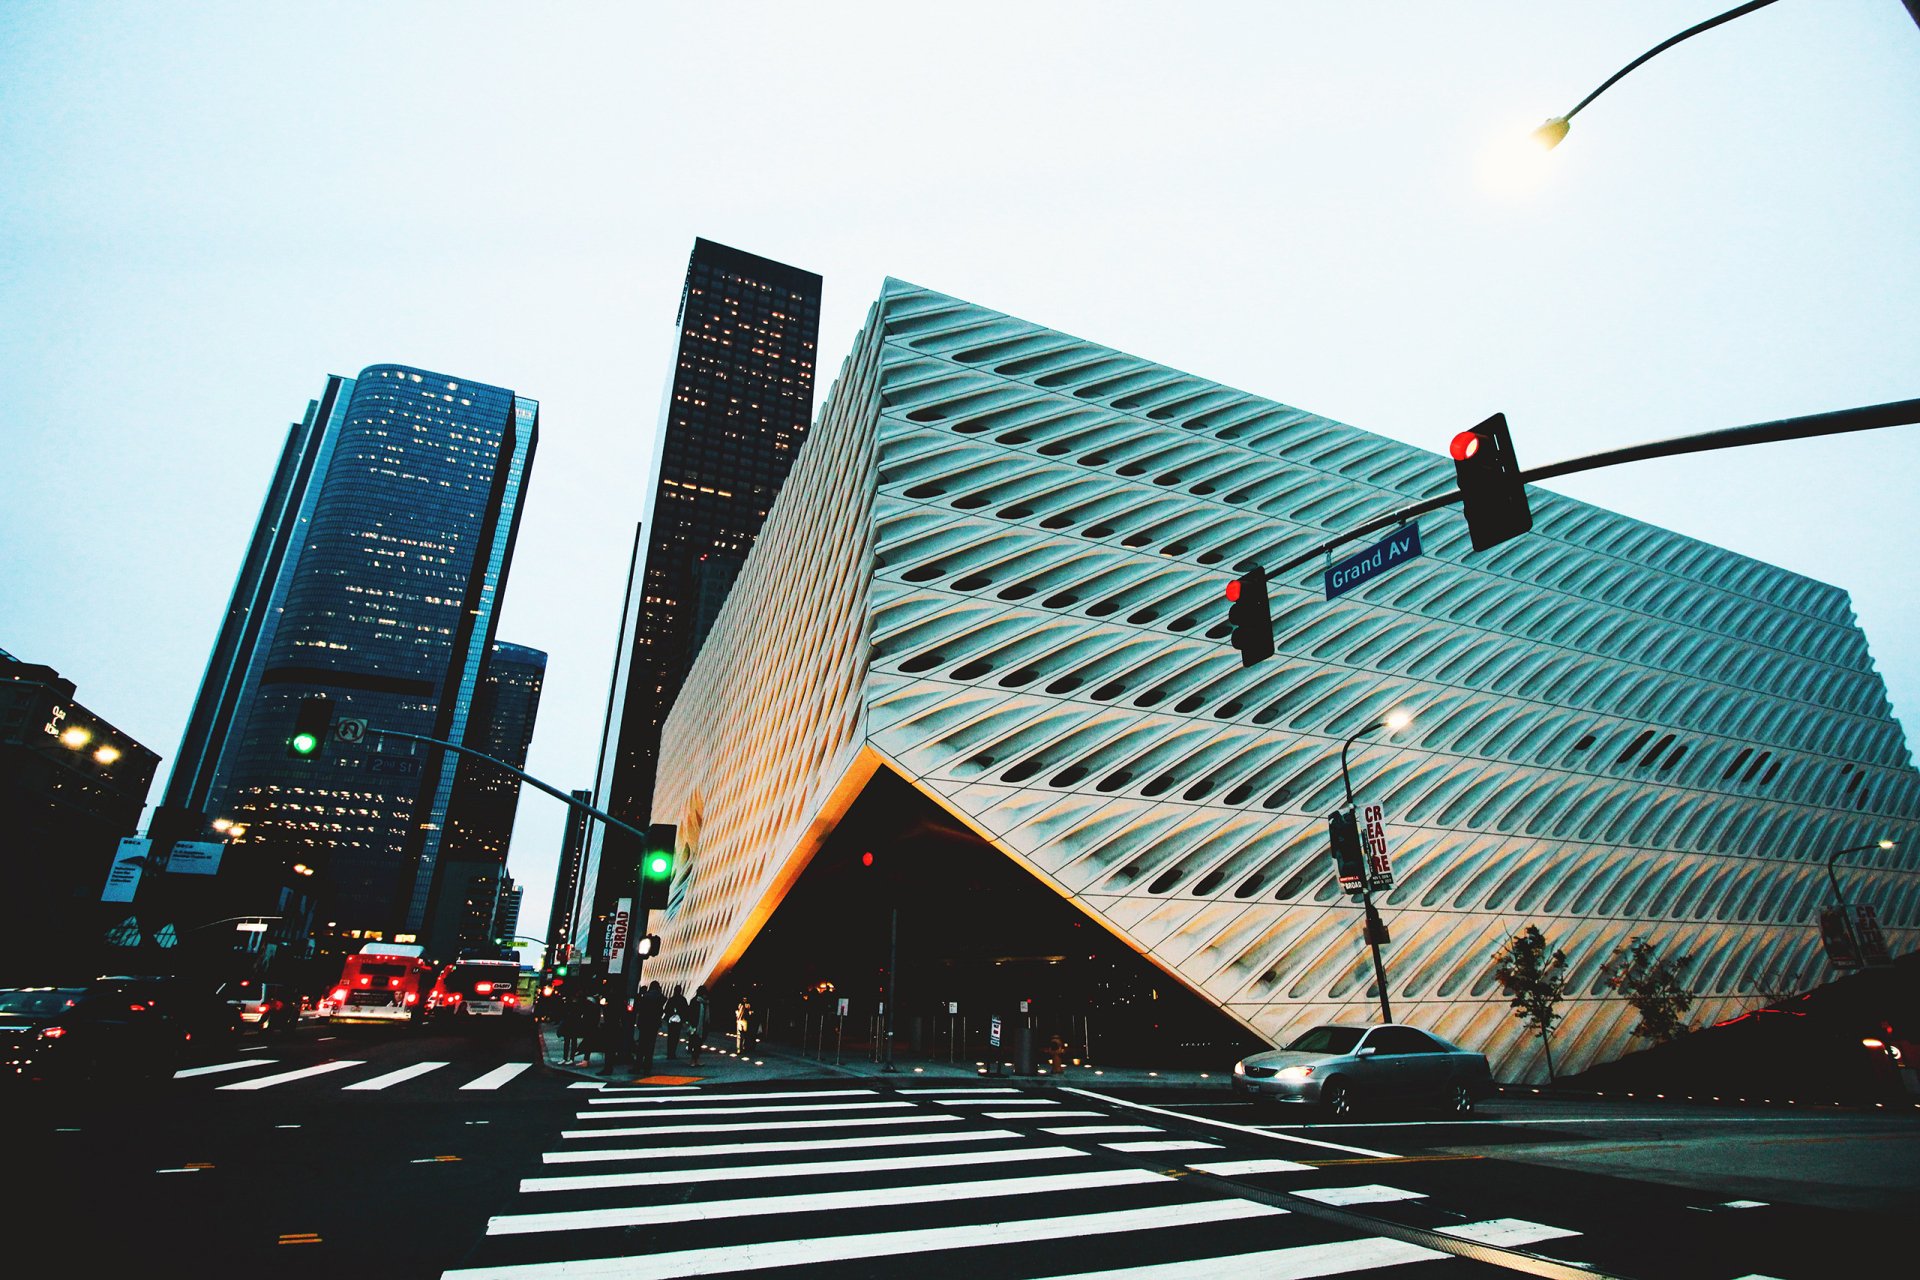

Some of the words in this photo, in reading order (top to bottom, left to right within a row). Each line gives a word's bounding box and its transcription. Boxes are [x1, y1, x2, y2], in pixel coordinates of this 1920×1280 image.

[1332, 549, 1382, 588] Grand
[1388, 537, 1410, 560] Av
[372, 758, 396, 771] 2nd
[399, 761, 412, 773] St
[1365, 806, 1382, 822] CR
[1366, 822, 1384, 839] EA
[1369, 838, 1387, 855] TU
[1372, 855, 1391, 873] RE
[613, 911, 628, 949] BROAD
